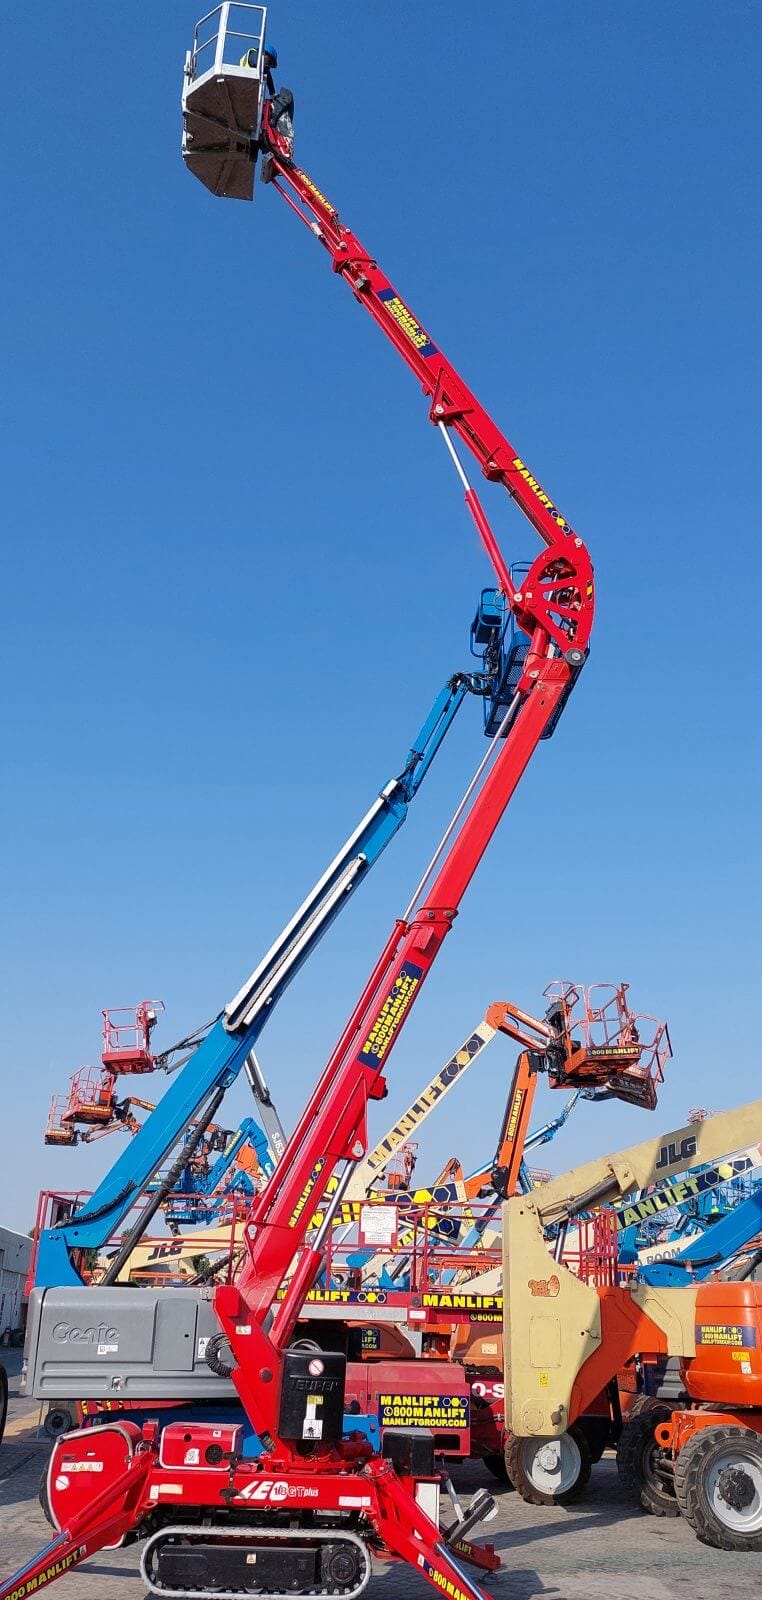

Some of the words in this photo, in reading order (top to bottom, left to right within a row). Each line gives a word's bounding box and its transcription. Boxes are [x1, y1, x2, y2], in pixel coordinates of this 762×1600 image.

[393, 298, 419, 329] MANLIFT
[512, 458, 553, 509] MANLIFT
[363, 996, 394, 1054] MANLIFT
[377, 978, 419, 1059] MANLIFTGROUP.COM
[369, 1076, 447, 1169] MANLIFT
[656, 1136, 697, 1170] JLG
[288, 1179, 314, 1228] MANLIFT
[147, 1240, 184, 1261] JLG
[423, 1294, 503, 1308] MANLIFT
[52, 1322, 120, 1345] Genie
[380, 1395, 440, 1406] MANLIFT
[393, 1406, 466, 1418] 800MANLIFT
[382, 1417, 467, 1428] MANLIFTGROUP.COM
[237, 1480, 289, 1501] LEO
